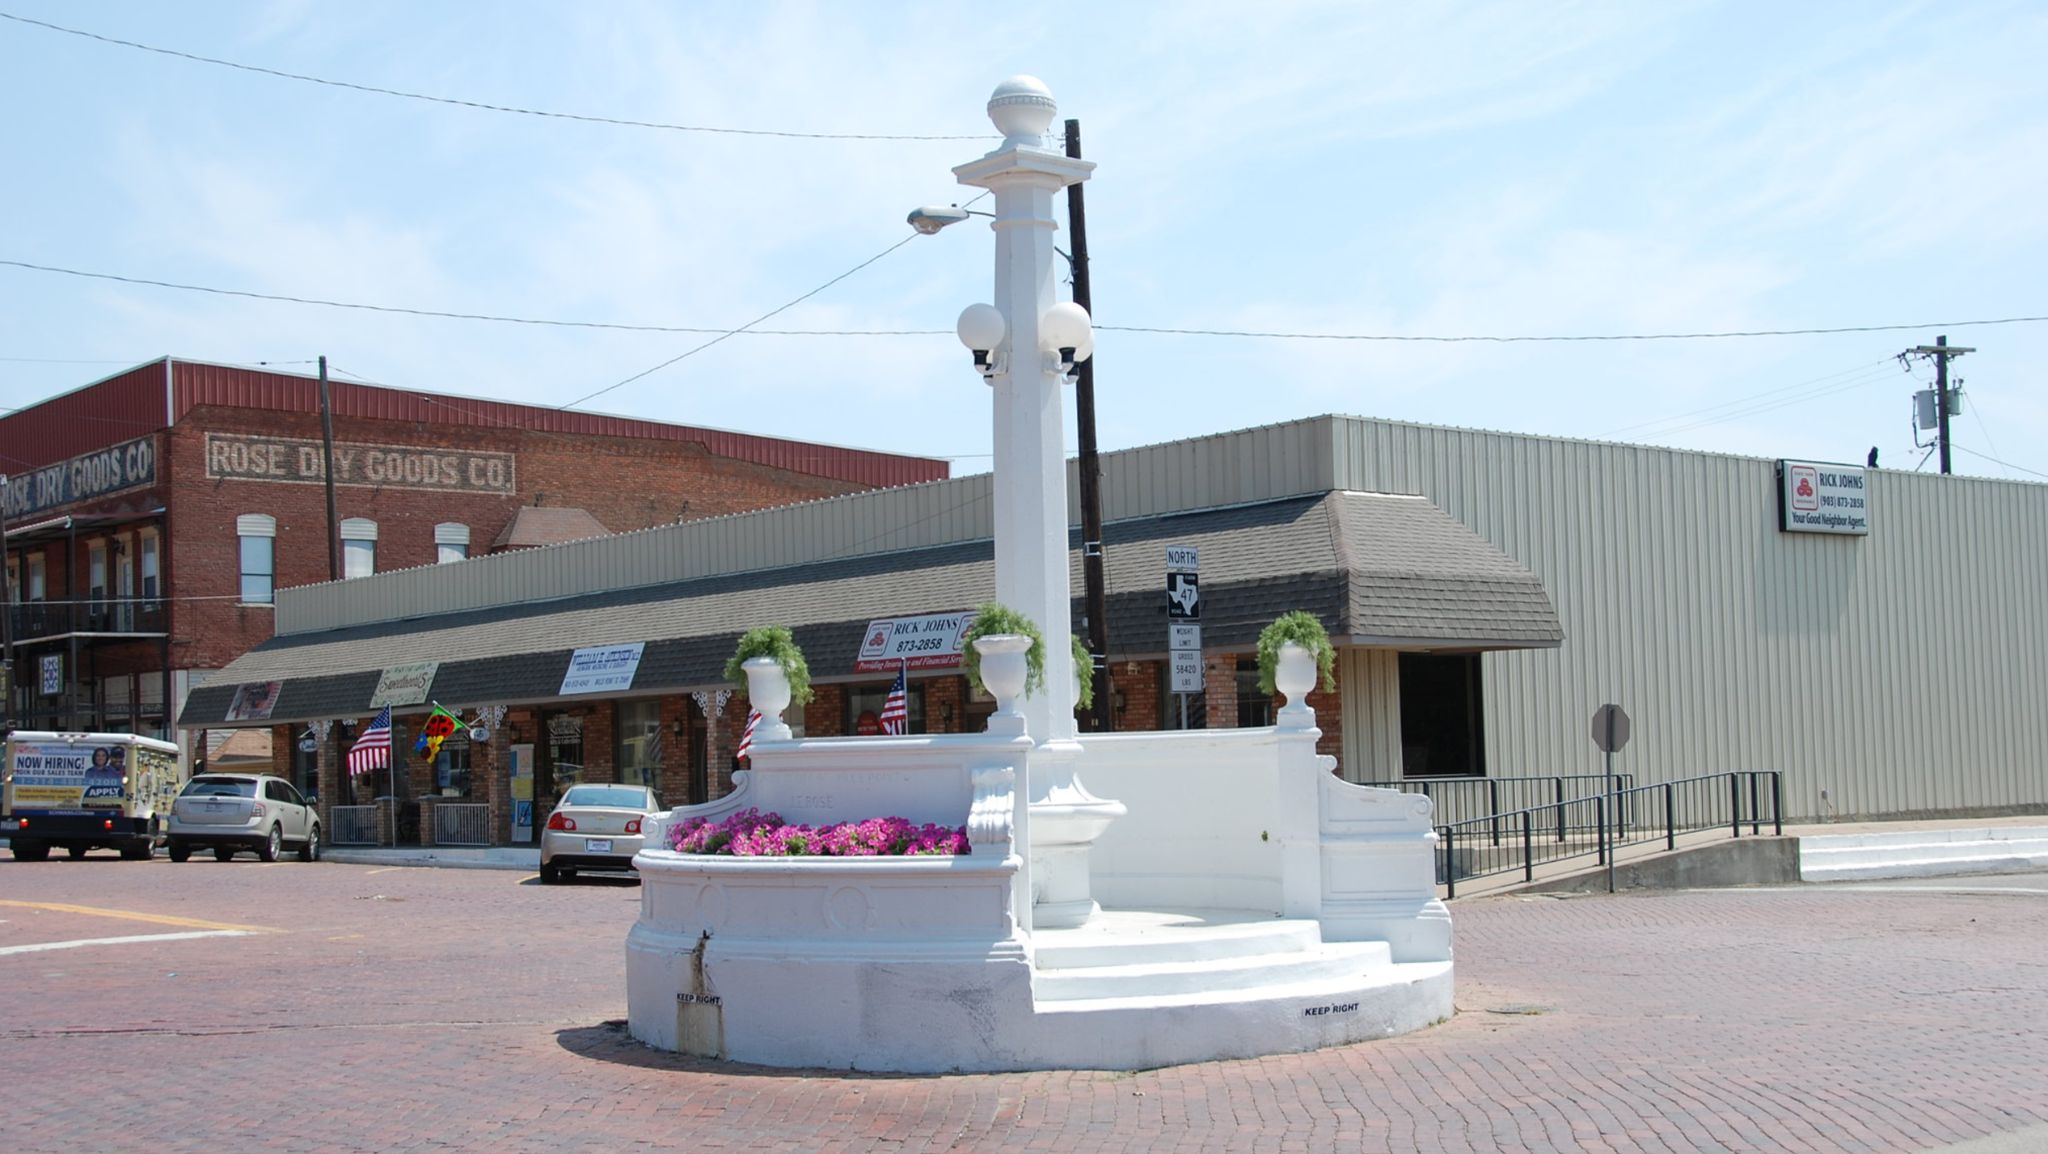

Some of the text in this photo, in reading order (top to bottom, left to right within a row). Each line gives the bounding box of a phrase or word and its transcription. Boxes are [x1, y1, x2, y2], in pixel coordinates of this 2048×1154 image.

[211, 441, 286, 475] ROSE
[366, 451, 458, 485] GOODS
[468, 457, 511, 487] CO.
[36, 465, 67, 507] DRY
[71, 449, 121, 498] GOODS
[1819, 472, 1864, 489] RICK JOHNS
[1820, 495, 1864, 508] (903) 873-2858
[1792, 512, 1805, 524] Your
[1807, 512, 1820, 525] Good
[1822, 513, 1847, 528] Neighbor
[1168, 551, 1197, 564] NORTH
[1180, 588, 1193, 601] 47
[894, 618, 958, 635] RICK JOHNS
[896, 638, 942, 653] 873-2858
[1176, 664, 1196, 674] 58420
[17, 756, 85, 769] NOW HIRING!
[89, 787, 119, 796] APPLY
[677, 993, 720, 1004] KEEP RIGHT
[1305, 1003, 1359, 1016] KEEP RIGHT
